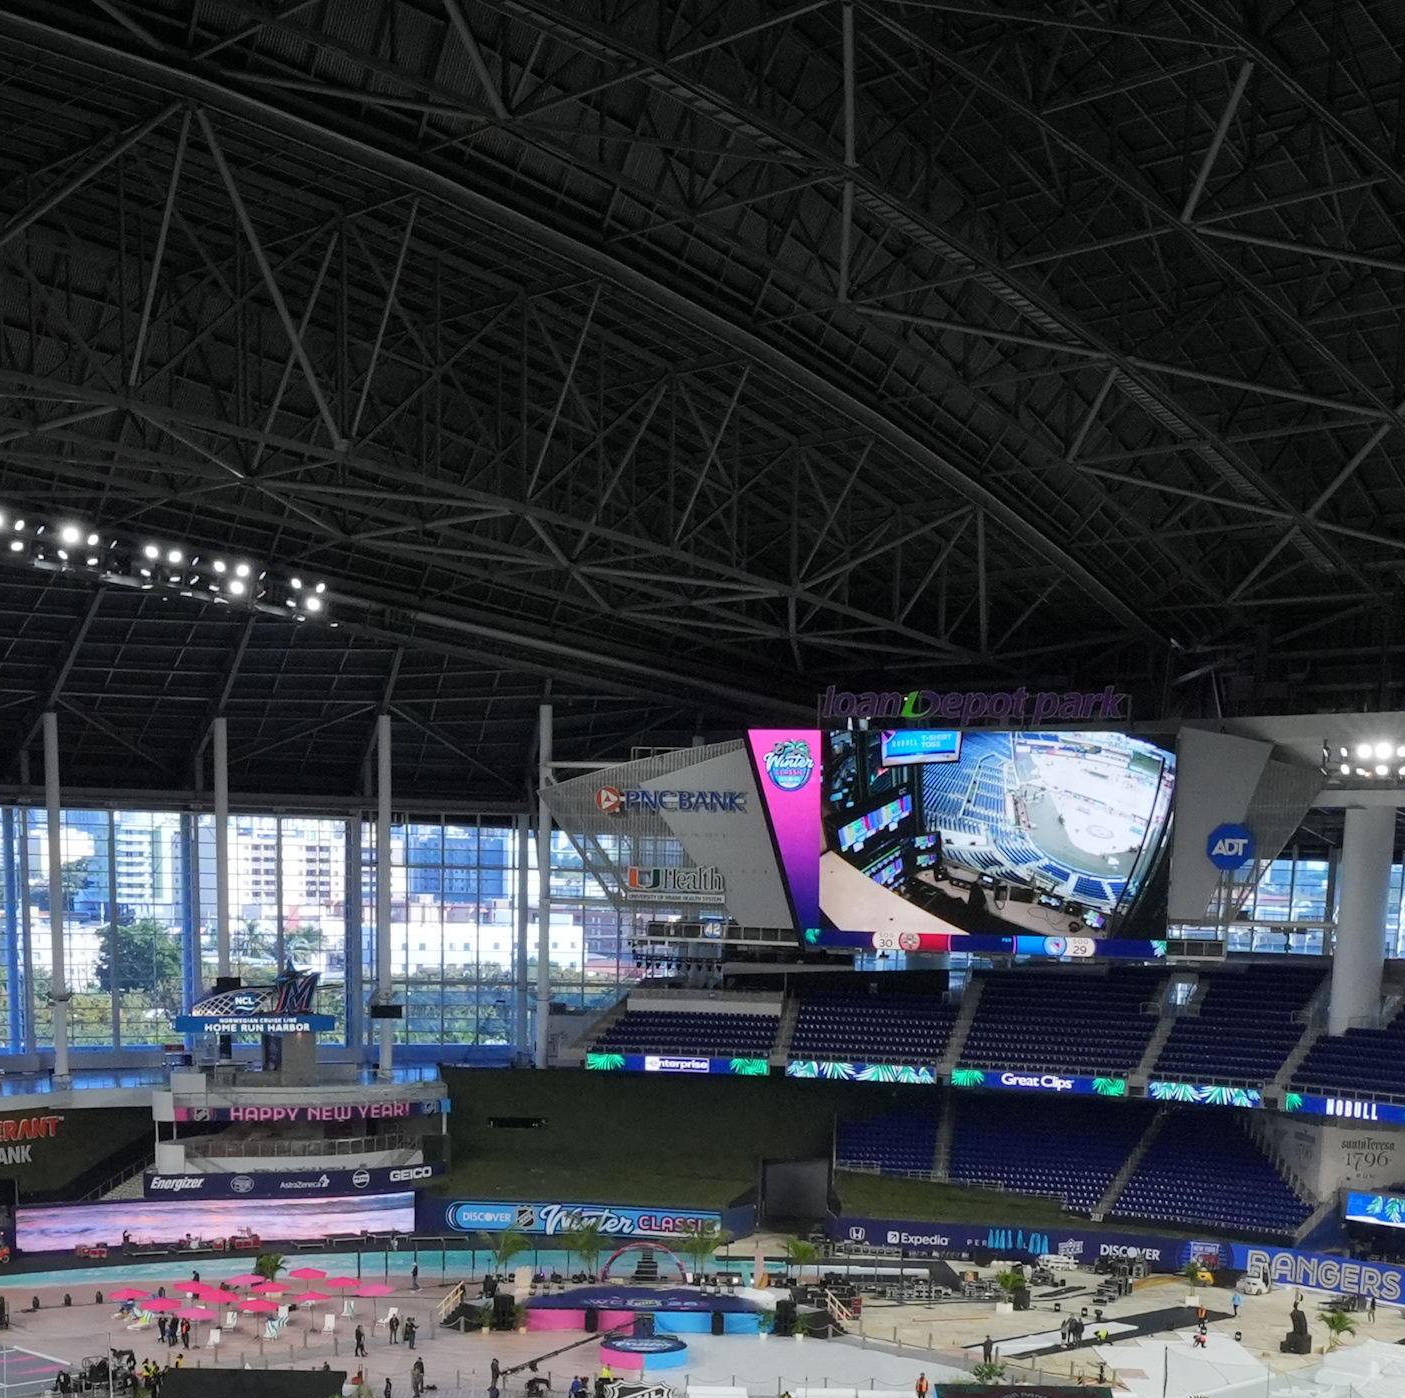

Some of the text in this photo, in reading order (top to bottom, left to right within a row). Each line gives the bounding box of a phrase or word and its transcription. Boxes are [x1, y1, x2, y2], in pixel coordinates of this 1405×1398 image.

[822, 685, 1124, 726] loanDepot park
[762, 751, 815, 772] Winter
[1211, 838, 1248, 856] ADT
[705, 922, 721, 936] 42
[878, 938, 893, 948] 30
[1073, 946, 1088, 955] 29
[234, 996, 254, 1006] NCL
[204, 1022, 311, 1033] HOME RUN HARBOR
[1001, 1072, 1074, 1091] Great Clips
[229, 1102, 411, 1121] HAPPY NEW YEAR!
[1325, 1098, 1379, 1121] NOBULL
[1345, 1151, 1390, 1172] 1796
[389, 1165, 433, 1183] GEICO
[149, 1176, 205, 1192] Energizer
[279, 1179, 322, 1189] AstraZeneca
[462, 1203, 717, 1236] DISCOVER Winter CLASSIC
[901, 1232, 949, 1247] Expedia
[1099, 1244, 1161, 1262] DISCOVER
[1246, 1249, 1403, 1301] RANGERS
